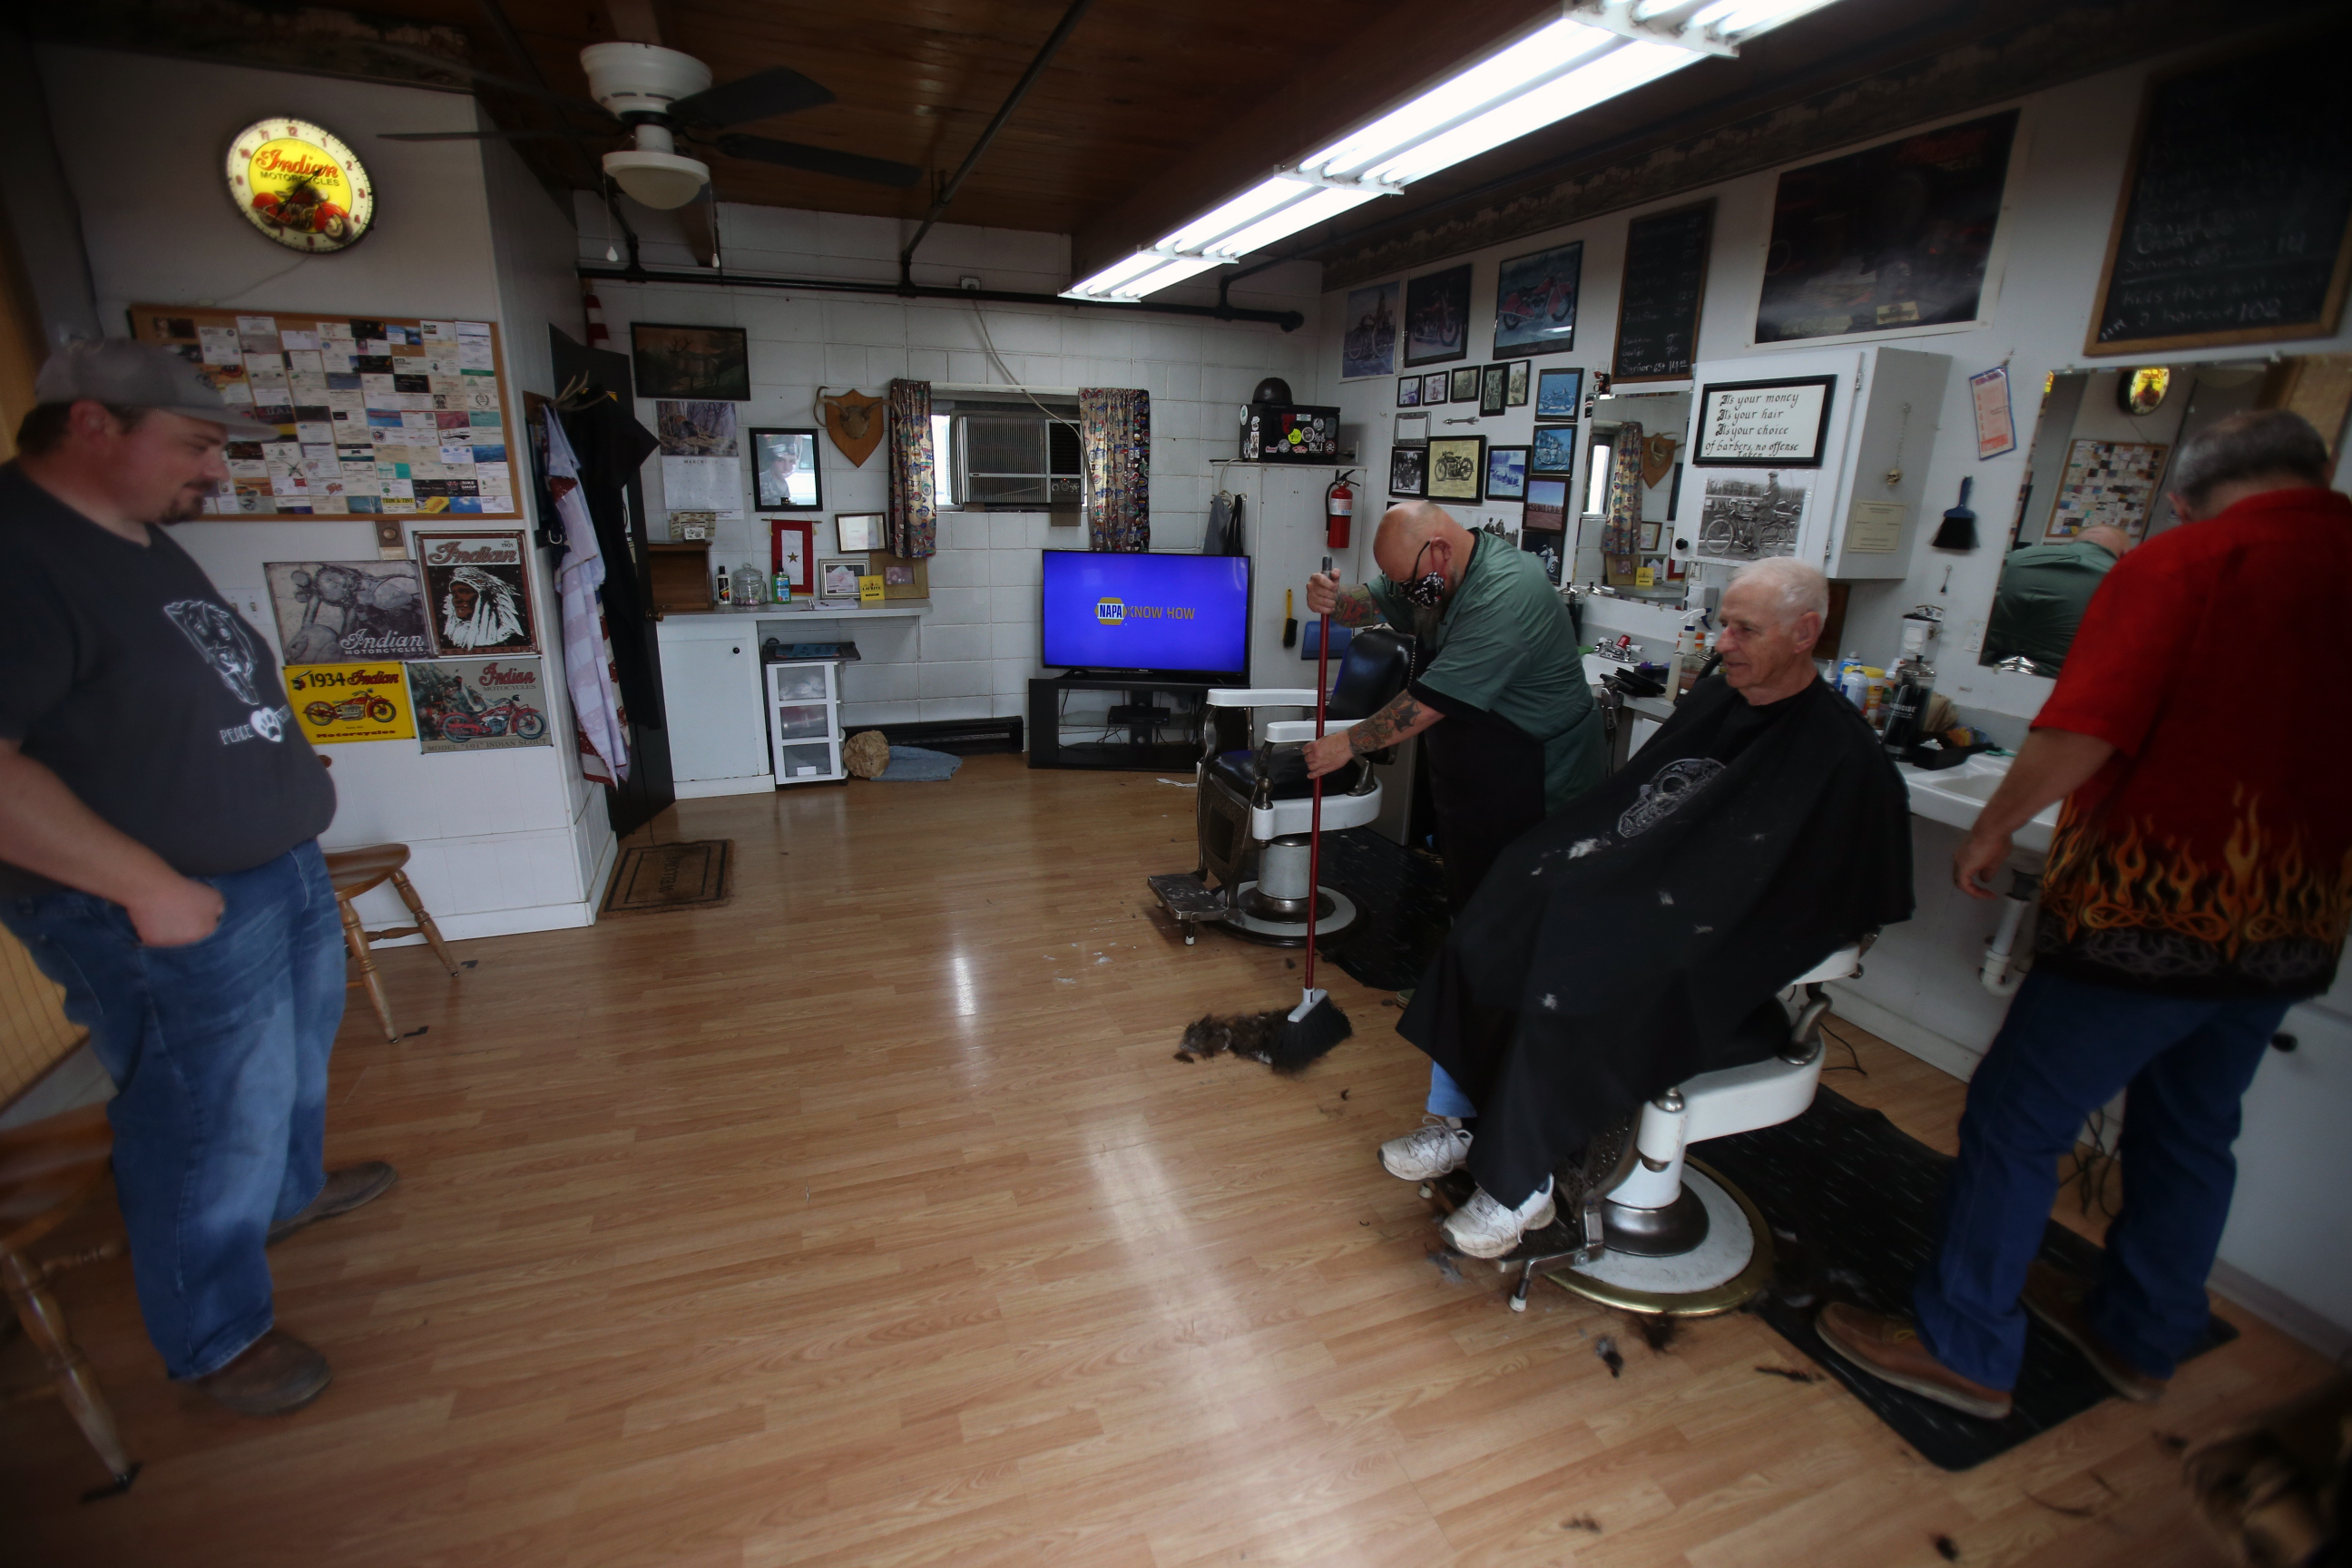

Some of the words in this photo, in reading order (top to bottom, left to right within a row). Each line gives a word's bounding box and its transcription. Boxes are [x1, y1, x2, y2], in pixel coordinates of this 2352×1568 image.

[255, 149, 338, 179] Indian
[260, 171, 340, 187] MOTORCYCLES
[1735, 396, 1762, 411] your
[1765, 393, 1799, 409] money
[1732, 411, 1758, 426] your
[1761, 408, 1784, 419] hair
[1730, 426, 1755, 442] your
[1757, 424, 1789, 436] choice
[1705, 439, 1716, 456] of
[1769, 441, 1799, 456] offense
[426, 541, 518, 564] Indian
[1099, 603, 1122, 619] NAPA
[1126, 605, 1163, 619] KNOW
[1166, 606, 1195, 621] HOW
[339, 628, 425, 650] Indian
[345, 647, 424, 655] MOTORCYCLES
[309, 671, 346, 687] 1934
[346, 670, 399, 685] Indian
[478, 662, 536, 686] Indian
[219, 723, 254, 745] PEACE
[317, 730, 396, 738] Motorcycles
[427, 740, 459, 751] MODEL
[486, 736, 515, 749] INDIAN
[518, 733, 546, 746] SCOUT
